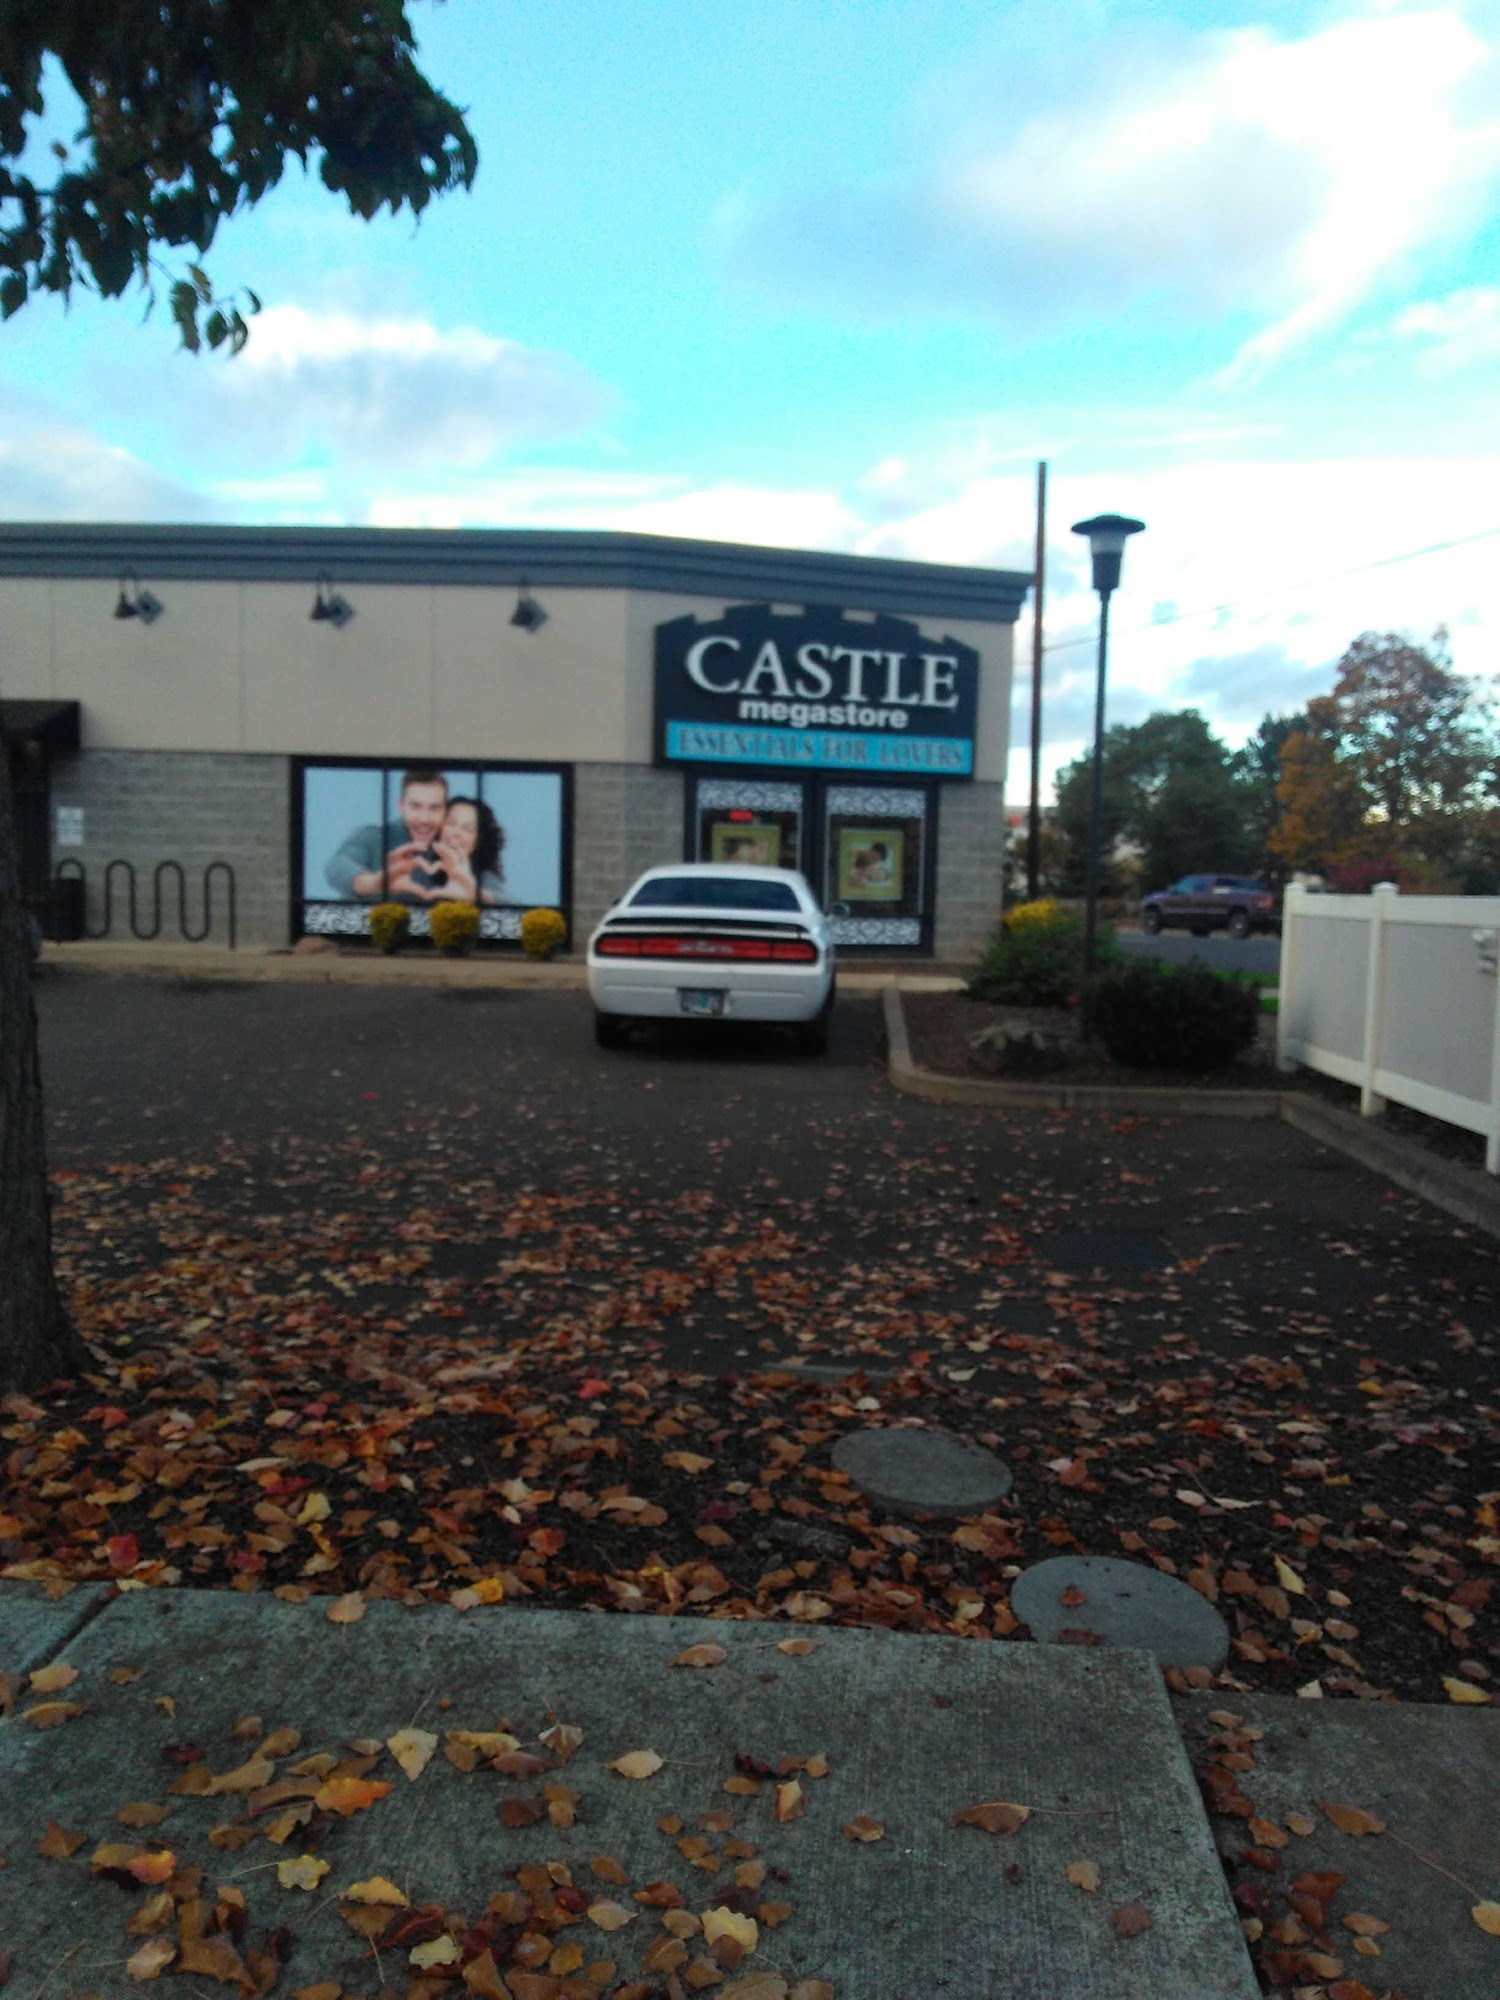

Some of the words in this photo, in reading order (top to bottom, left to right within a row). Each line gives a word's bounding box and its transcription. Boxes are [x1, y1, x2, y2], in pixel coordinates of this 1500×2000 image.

[686, 636, 960, 709] CASTLE
[739, 700, 909, 729] megastore
[678, 728, 814, 761] ESSENTIALS
[822, 736, 869, 764] FOR
[878, 740, 963, 769] LOVERS
